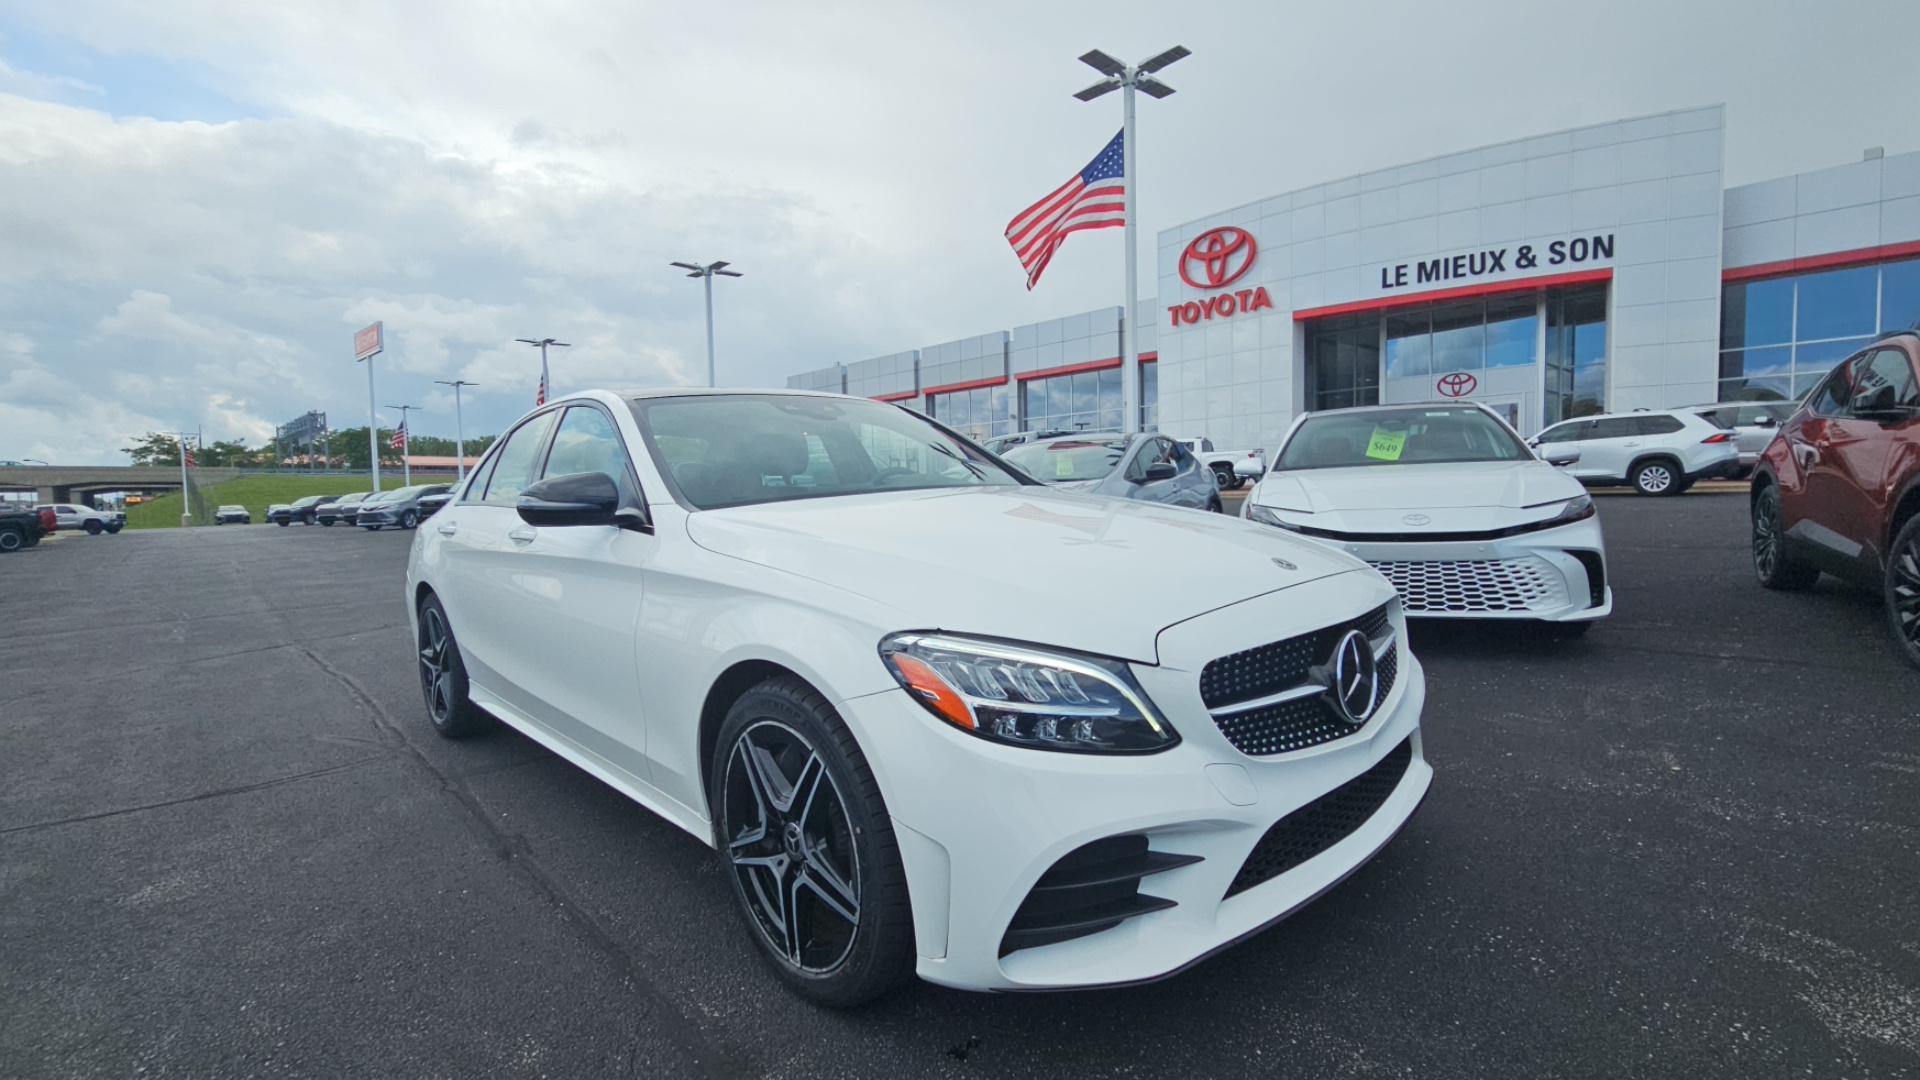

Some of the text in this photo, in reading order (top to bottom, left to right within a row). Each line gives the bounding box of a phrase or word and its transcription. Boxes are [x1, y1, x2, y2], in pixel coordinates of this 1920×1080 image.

[1381, 234, 1615, 289] LE MIEUX & SON
[1168, 286, 1273, 327] TOYOTA
